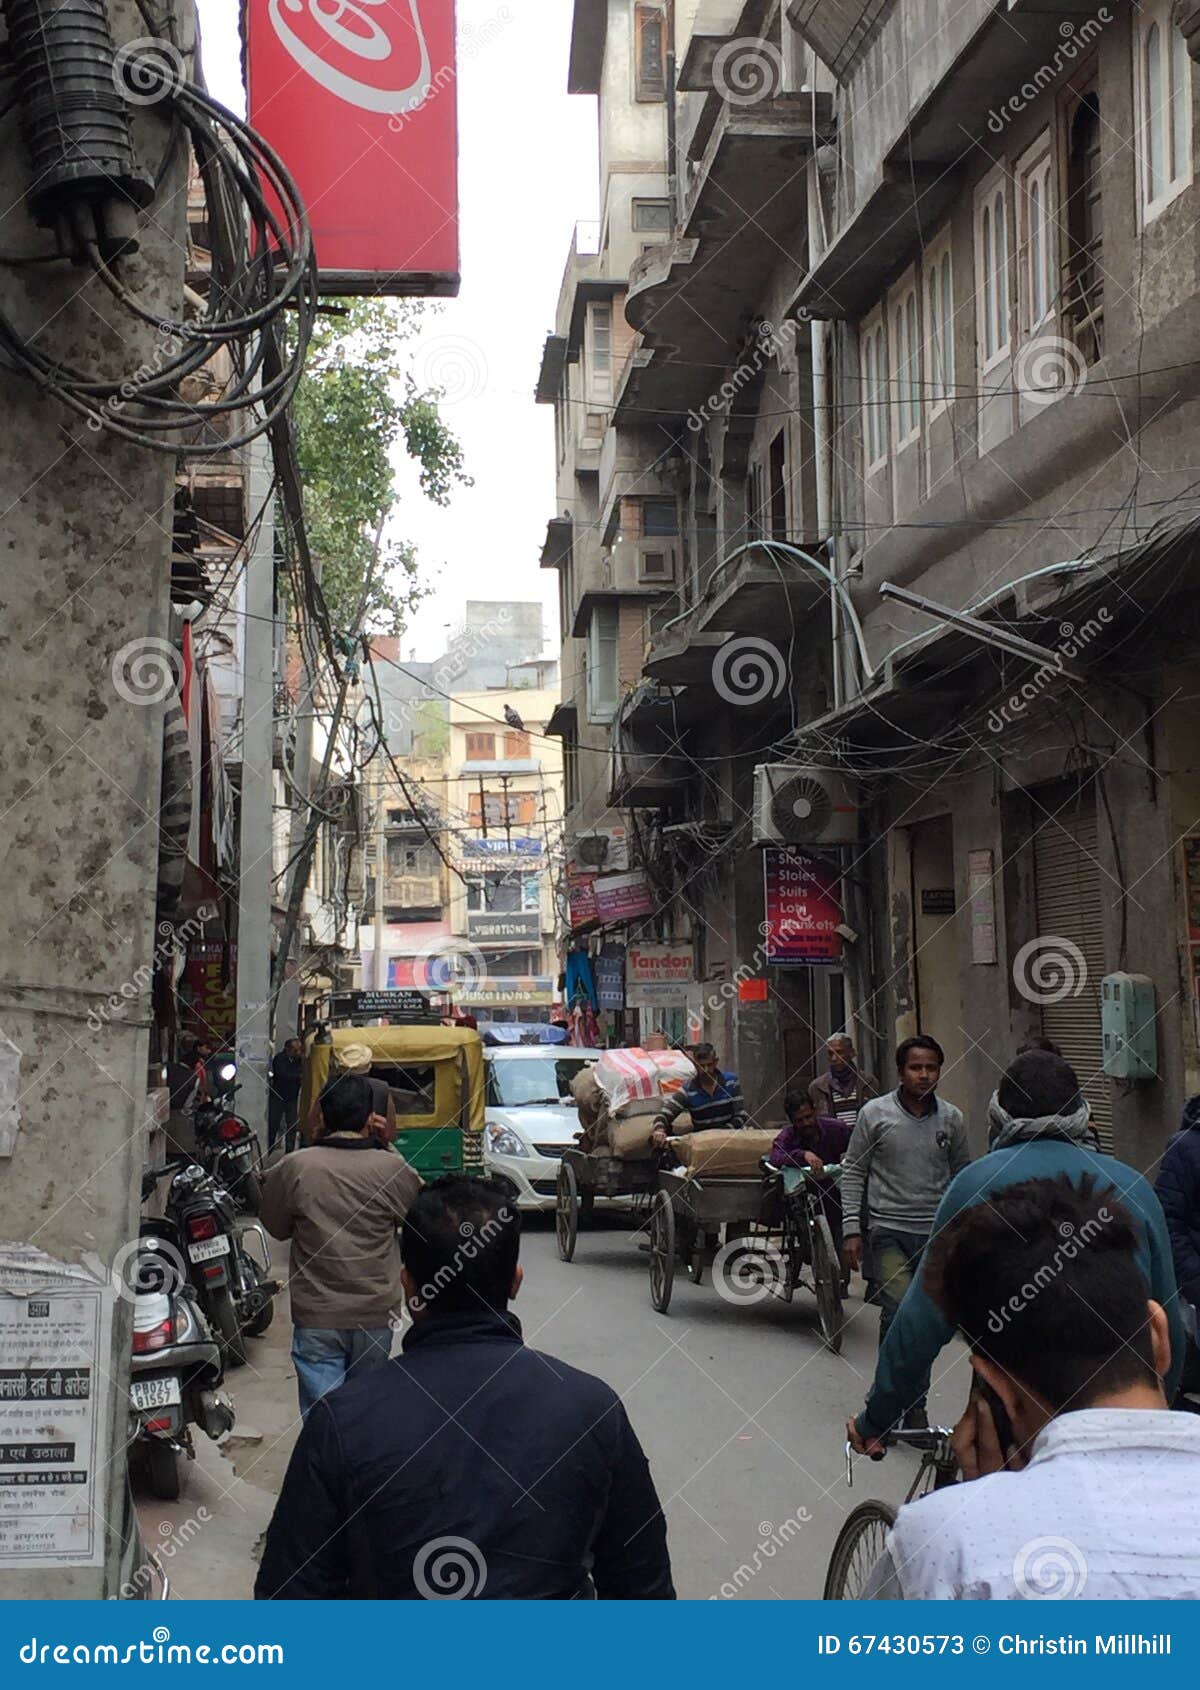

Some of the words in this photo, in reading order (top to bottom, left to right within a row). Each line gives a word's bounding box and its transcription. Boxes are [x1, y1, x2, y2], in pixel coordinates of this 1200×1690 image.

[779, 870, 817, 881] Stoles
[779, 886, 808, 897] Suits
[629, 951, 692, 969] Tandon
[135, 1379, 172, 1396] PB02C
